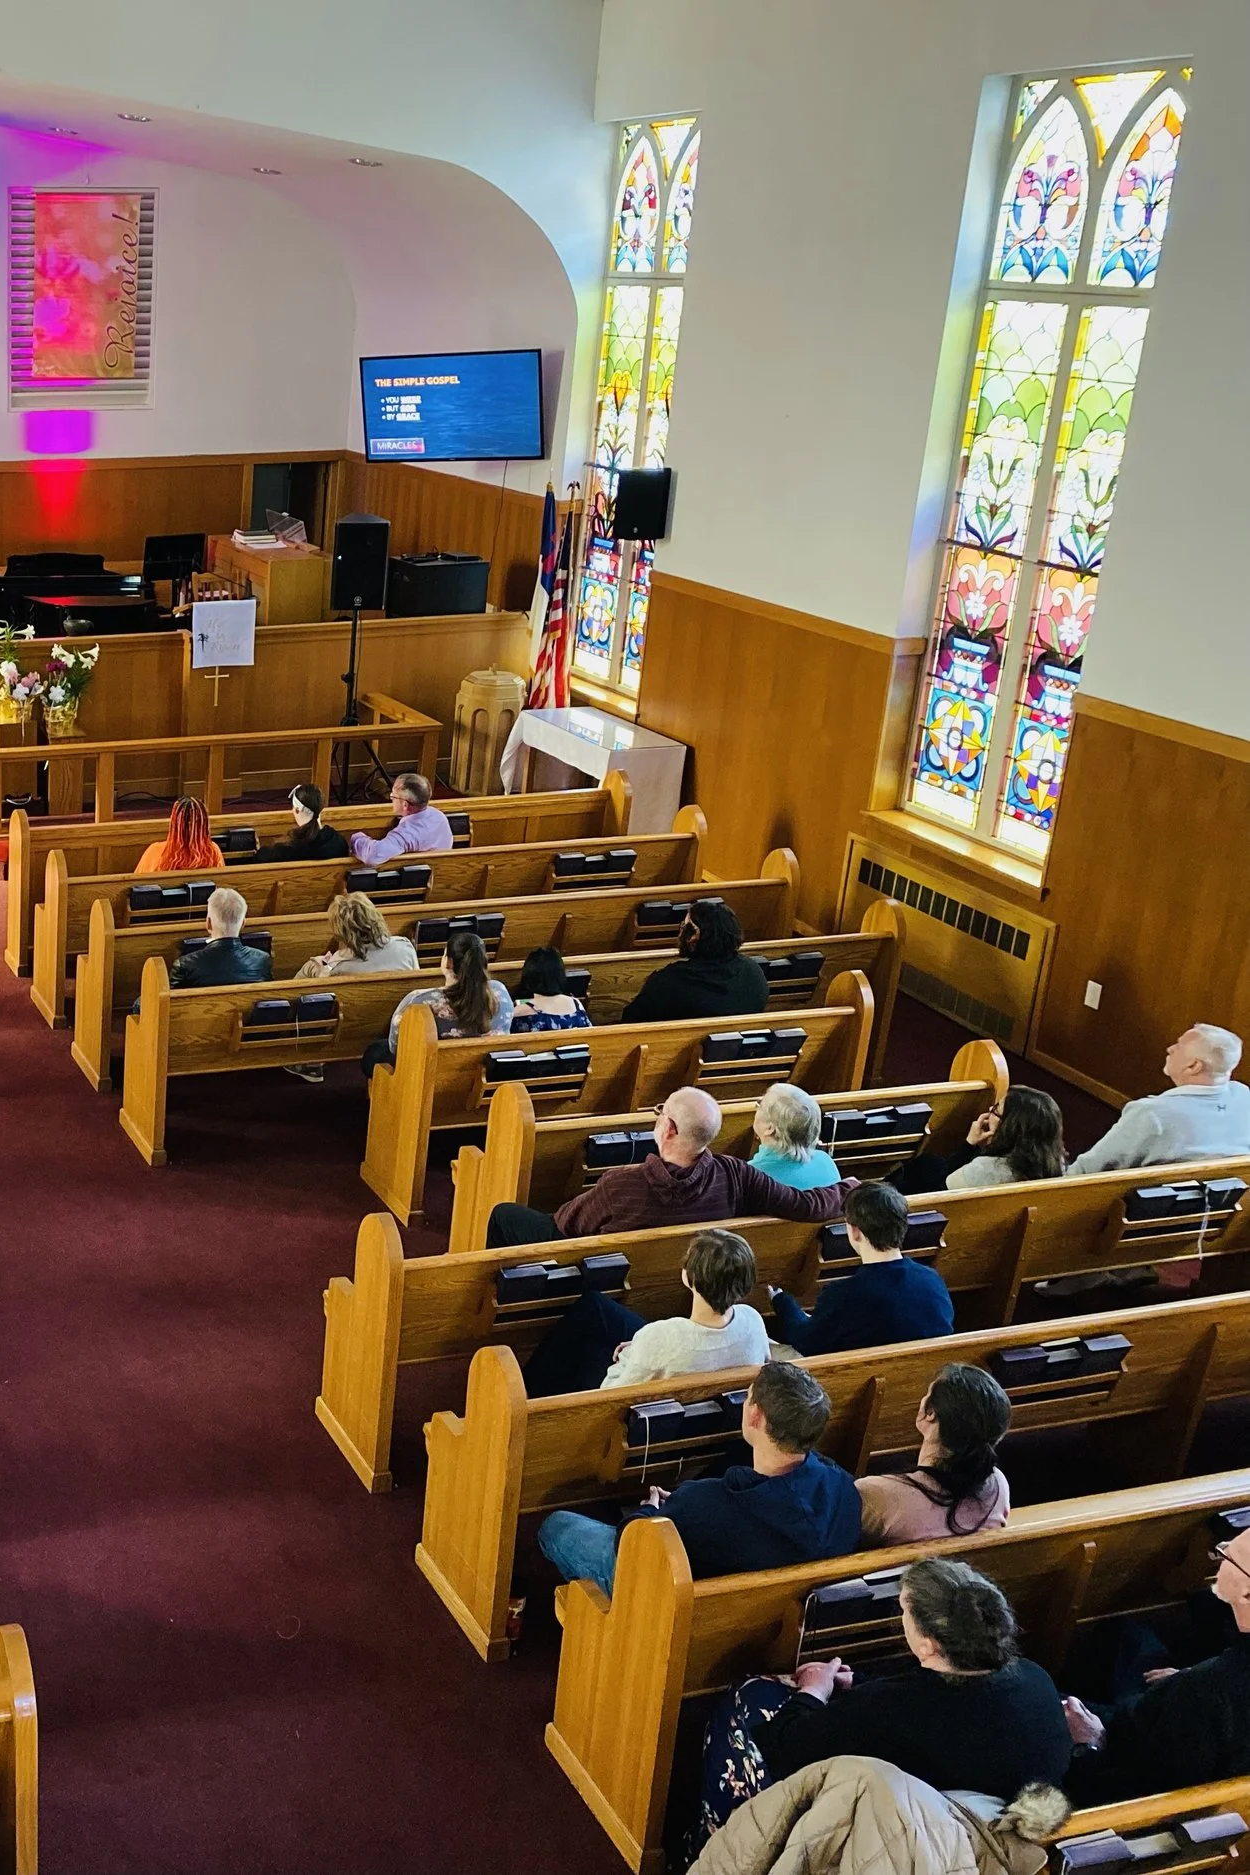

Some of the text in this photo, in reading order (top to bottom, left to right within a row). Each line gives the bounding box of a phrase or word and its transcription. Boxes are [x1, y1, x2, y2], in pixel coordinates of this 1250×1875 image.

[374, 375, 460, 388] THE SIMPLE GOSPEL
[385, 396, 400, 404] YOU
[376, 440, 418, 450] MIRACLES
